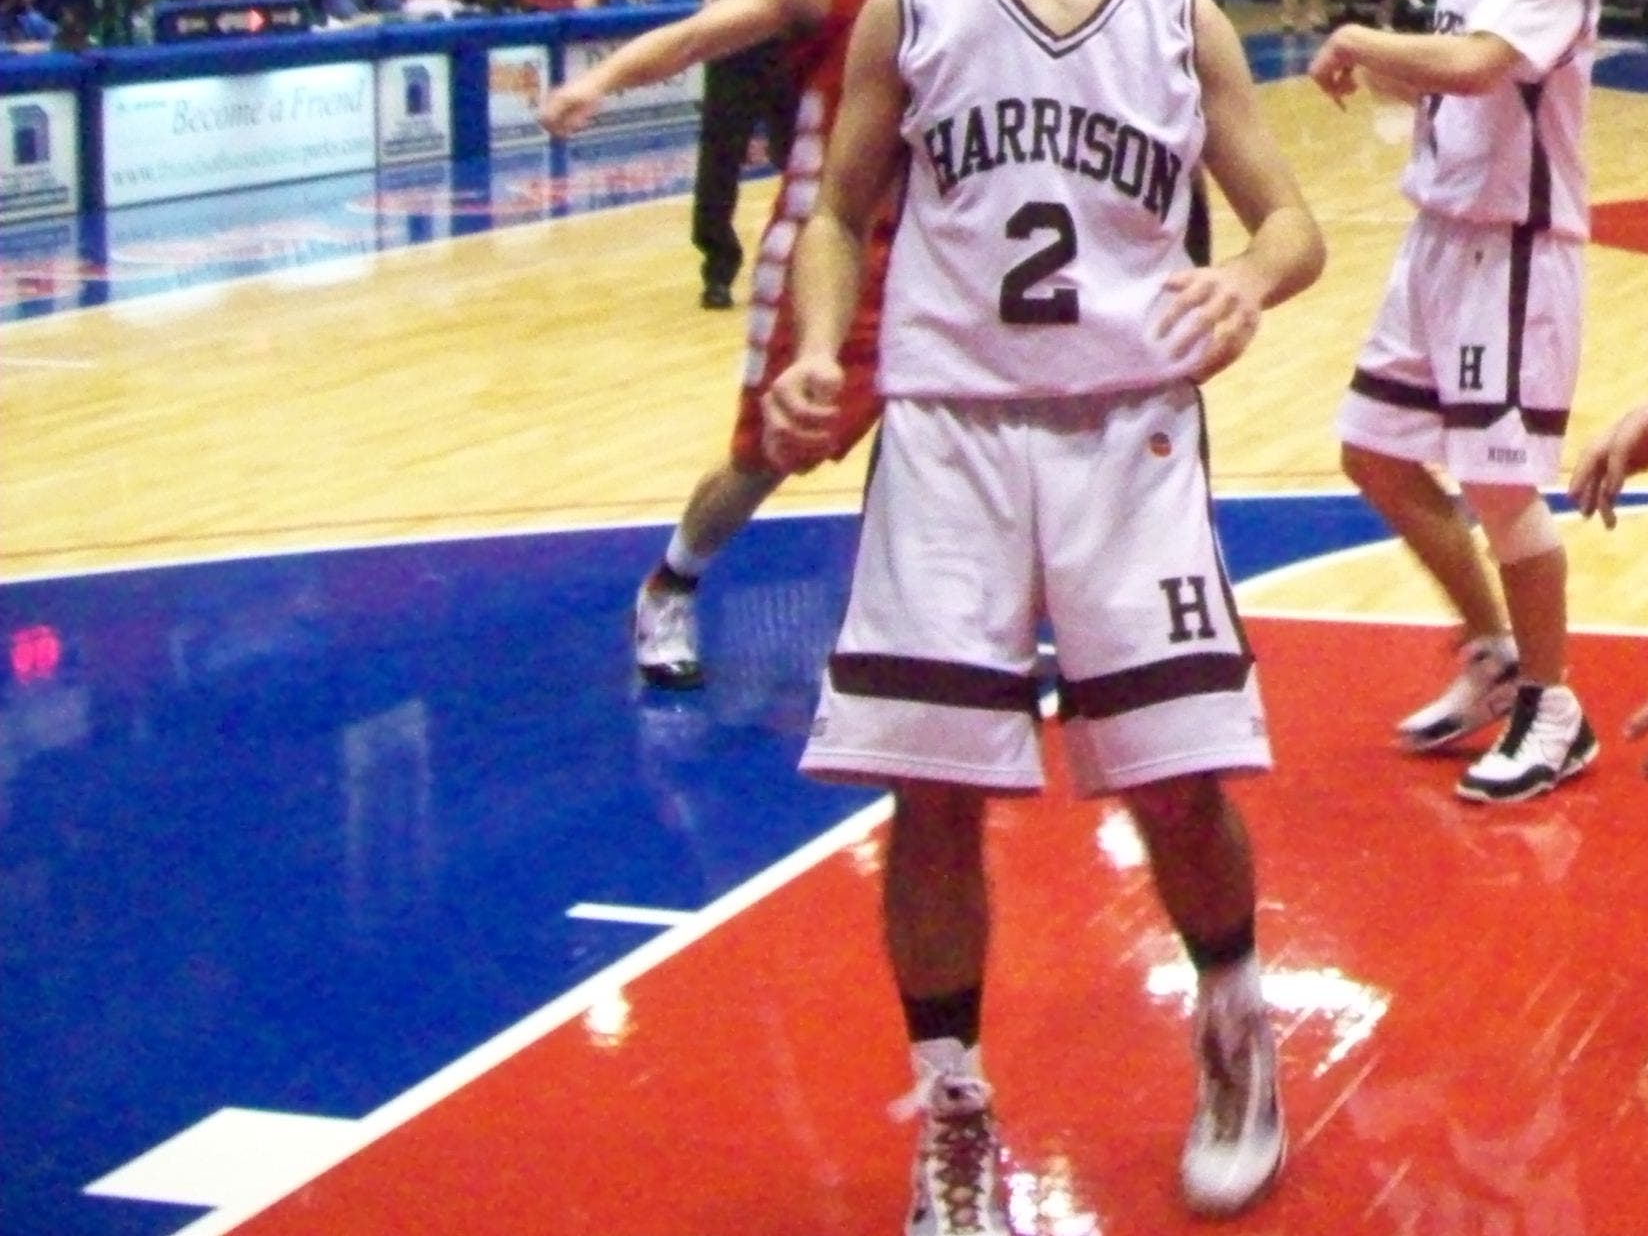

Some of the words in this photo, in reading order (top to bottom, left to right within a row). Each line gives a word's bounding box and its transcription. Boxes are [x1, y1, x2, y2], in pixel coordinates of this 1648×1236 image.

[924, 97, 1183, 226] HARRISON
[1000, 201, 1080, 325] 2
[1459, 345, 1486, 392] H
[1159, 575, 1217, 644] H
